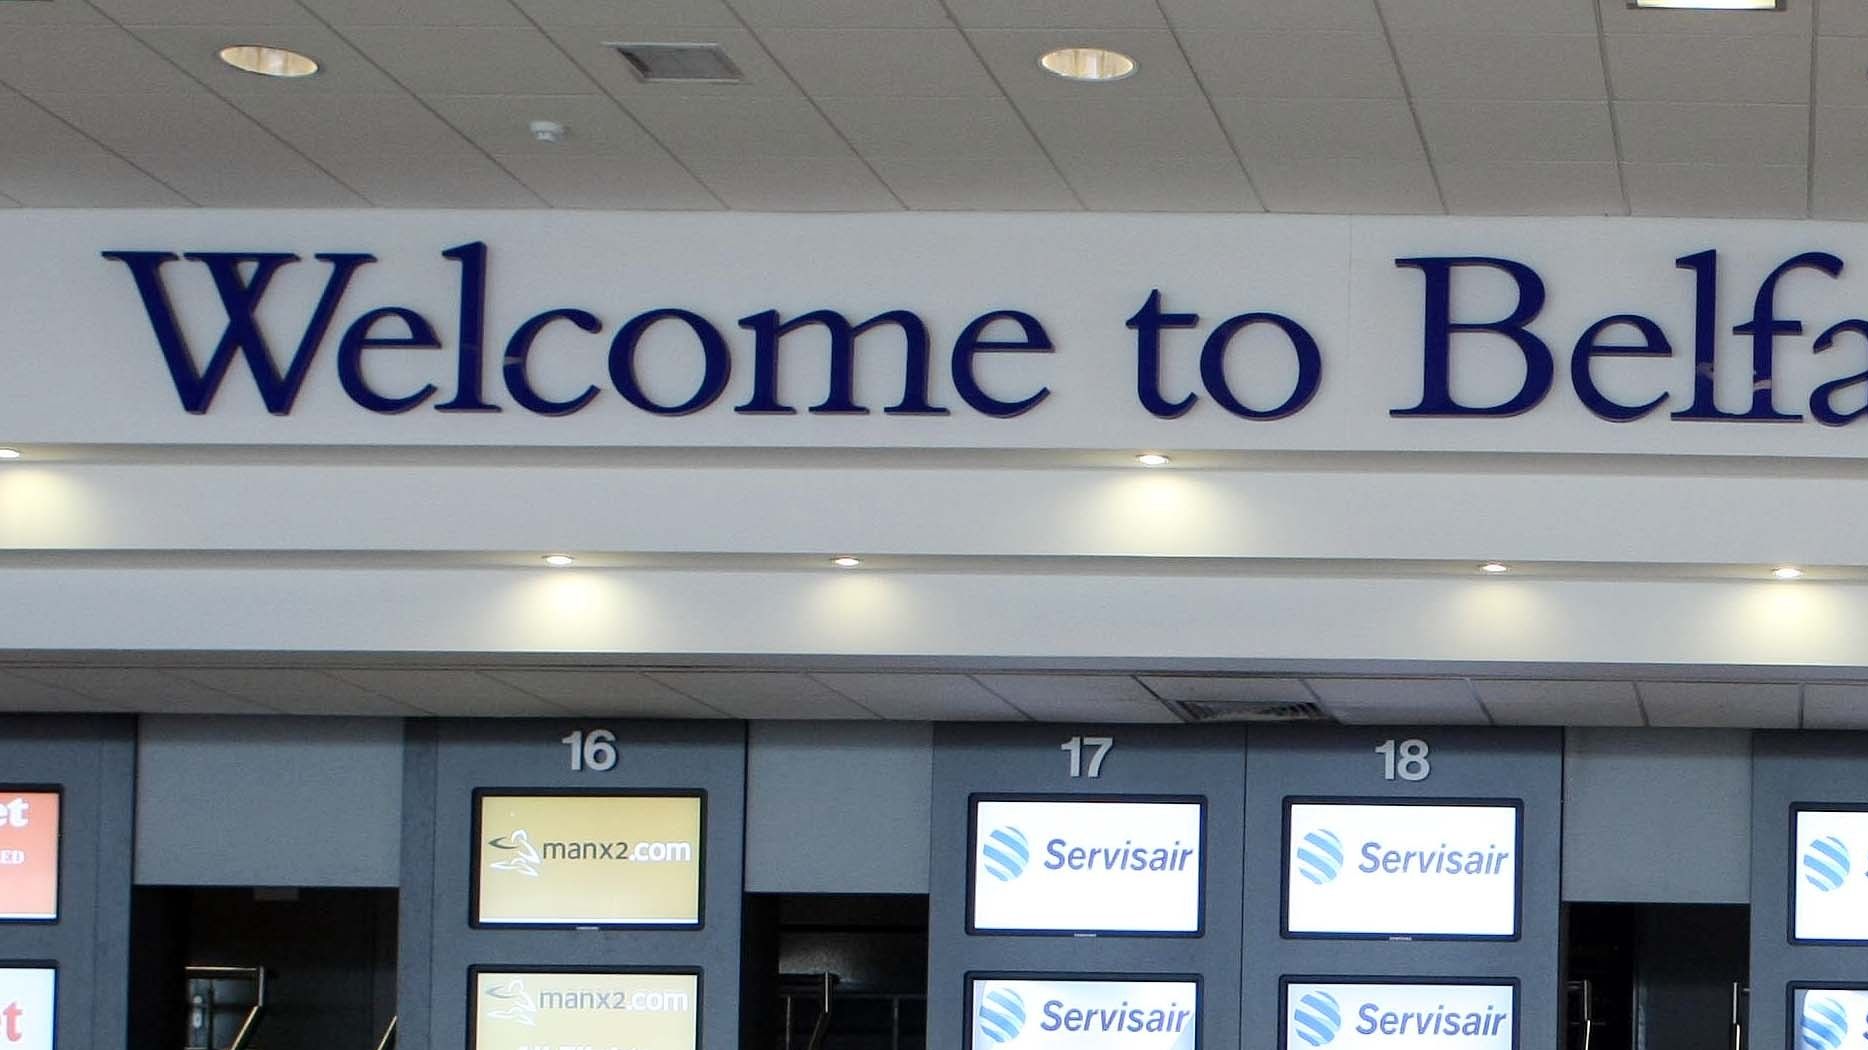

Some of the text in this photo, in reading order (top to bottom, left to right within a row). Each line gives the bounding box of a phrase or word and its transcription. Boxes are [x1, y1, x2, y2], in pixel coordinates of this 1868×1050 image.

[100, 240, 1058, 419] Welcome
[1123, 287, 1323, 421] to
[561, 729, 619, 773] 16
[1060, 736, 1114, 778] 17
[1374, 739, 1431, 781] 18
[541, 836, 692, 864] manx2.com
[1043, 838, 1194, 873] Servisair
[1358, 841, 1509, 876] Servisair
[538, 985, 689, 1012] manx2.com
[1040, 1000, 1192, 1034] Servisair
[1356, 1003, 1507, 1037] Servisair
